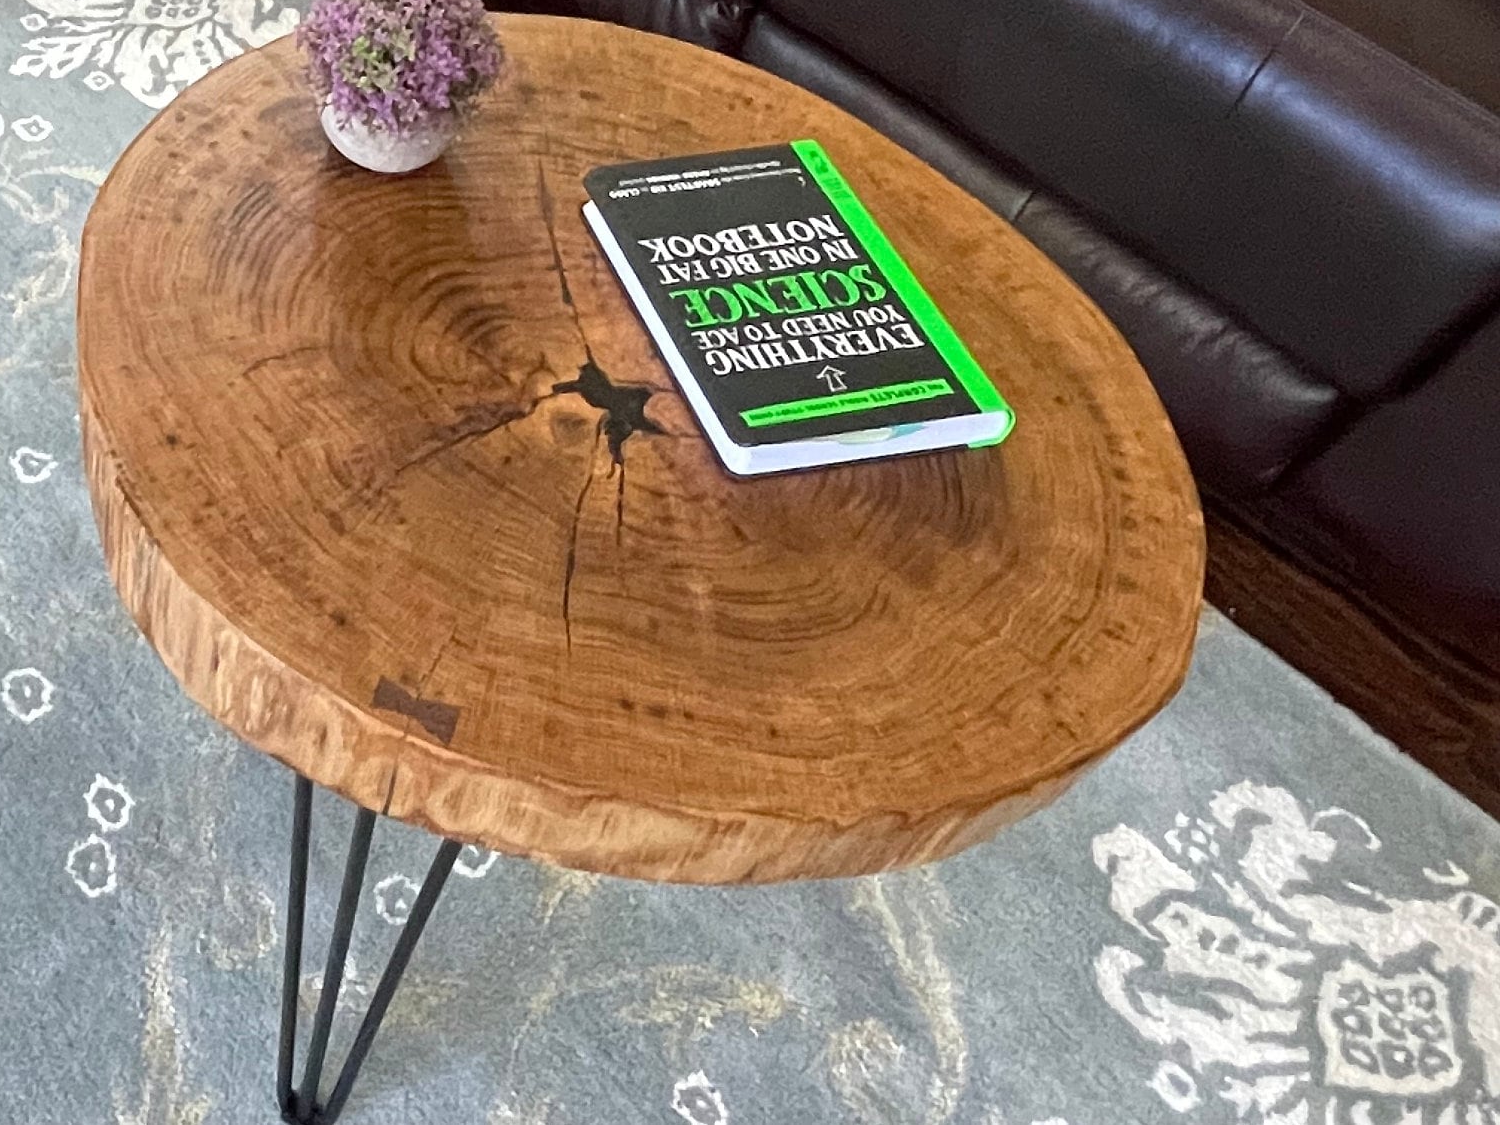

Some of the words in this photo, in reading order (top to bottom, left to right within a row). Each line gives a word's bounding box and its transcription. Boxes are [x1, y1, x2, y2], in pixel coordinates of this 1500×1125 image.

[638, 215, 844, 263] NOTEBOOK
[821, 239, 858, 263] IN
[710, 252, 763, 277] BIG
[760, 246, 822, 270] ONE
[657, 260, 709, 285] FAT
[668, 264, 887, 328] SCIENCE
[781, 311, 848, 337] NEED
[852, 304, 906, 327] YOU
[691, 326, 740, 350] ACE
[745, 321, 782, 342] TO
[705, 323, 926, 376] EVERYTHING
